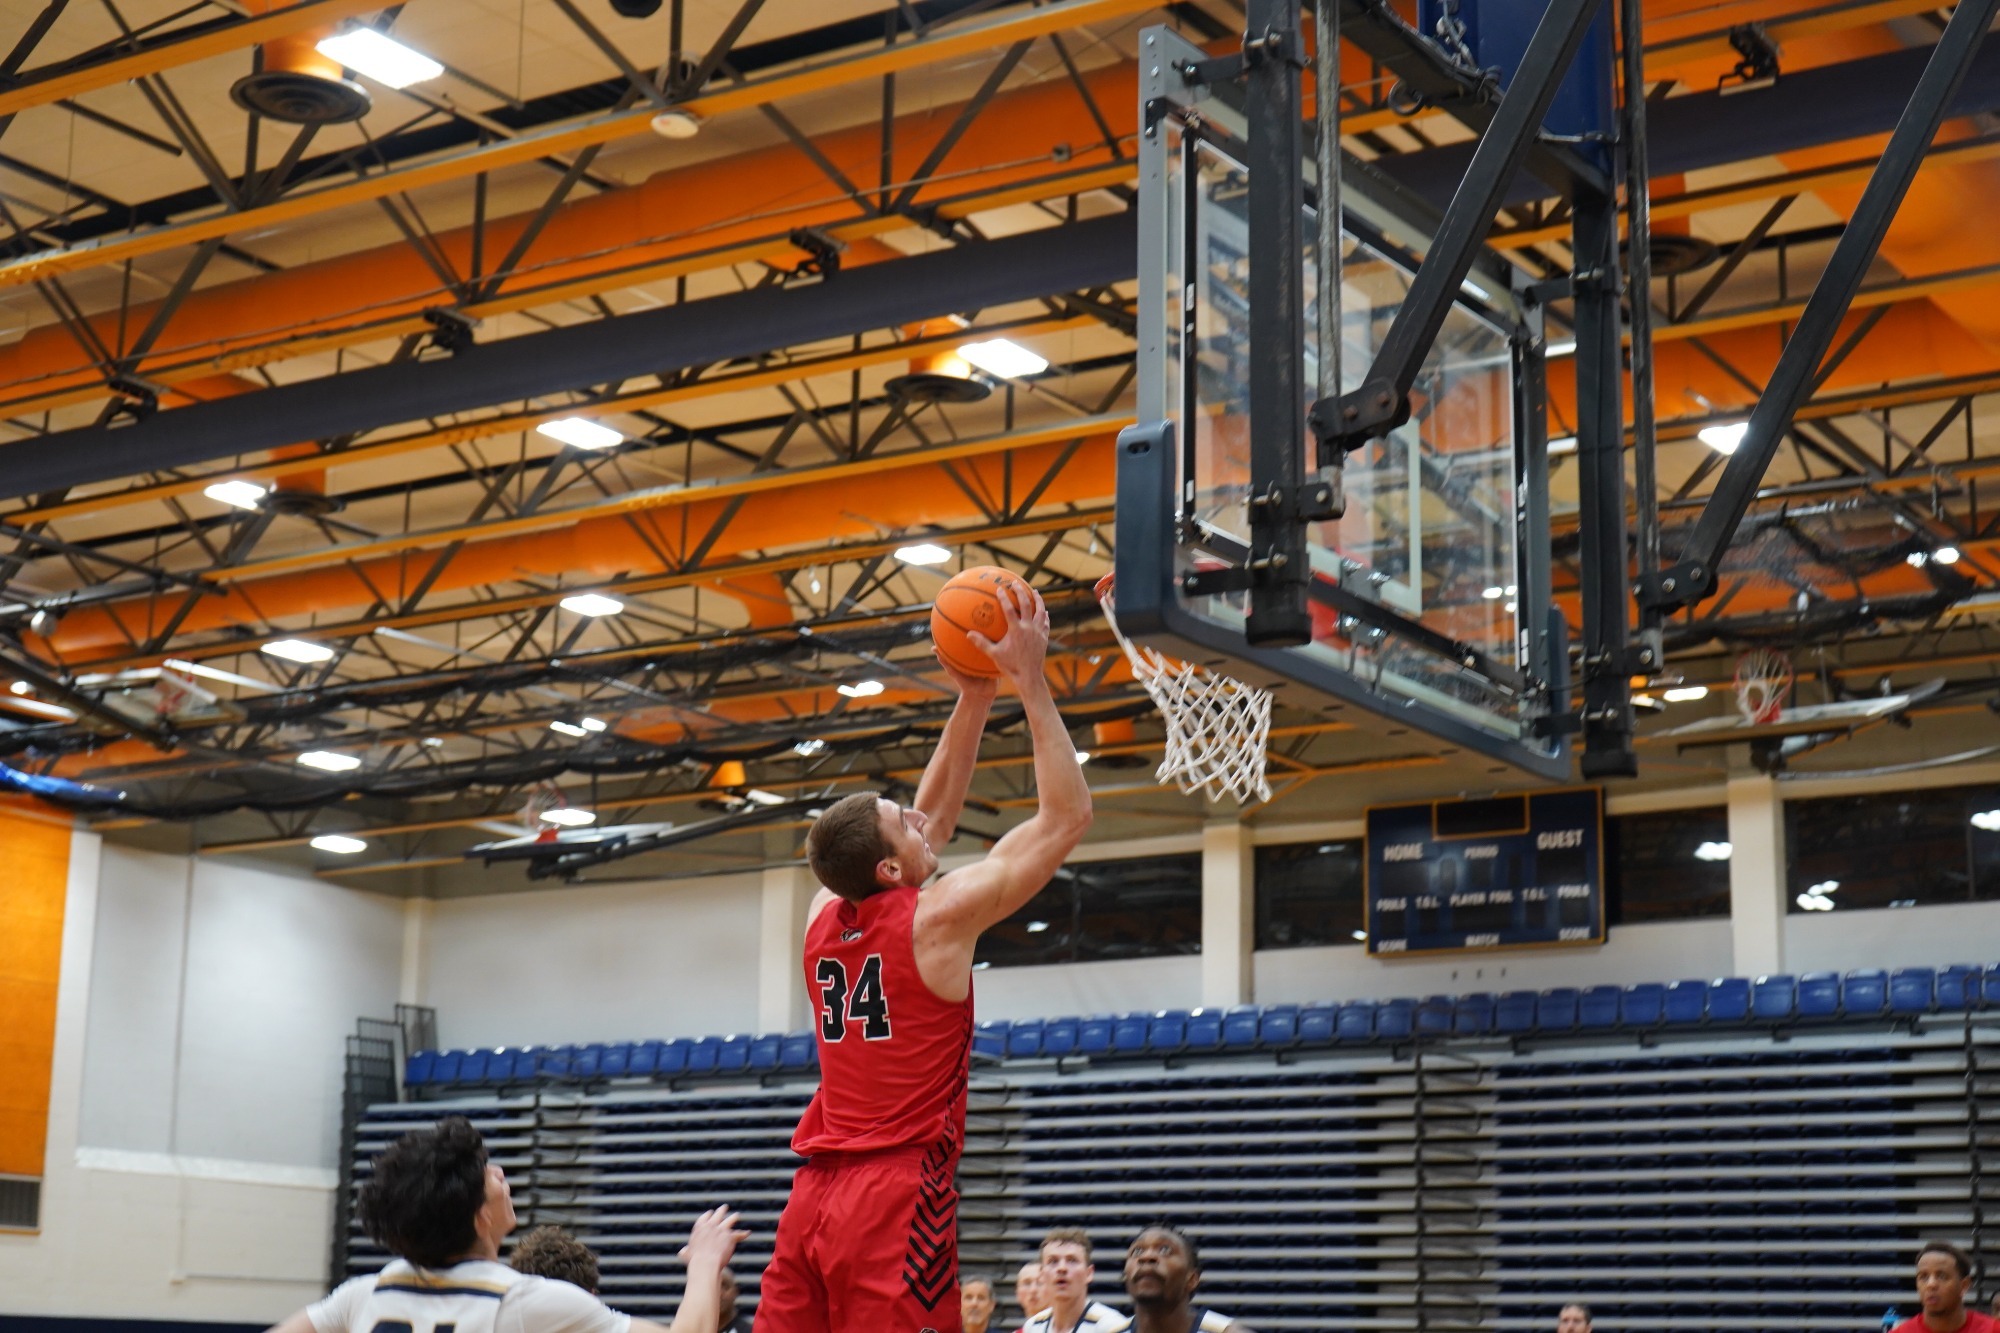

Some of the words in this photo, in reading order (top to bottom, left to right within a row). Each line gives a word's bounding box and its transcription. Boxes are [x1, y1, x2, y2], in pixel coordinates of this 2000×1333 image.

[1537, 829, 1584, 850] GUEST
[1384, 842, 1424, 862] HOME
[1450, 892, 1486, 907] PLAYER
[815, 953, 893, 1043] 34
